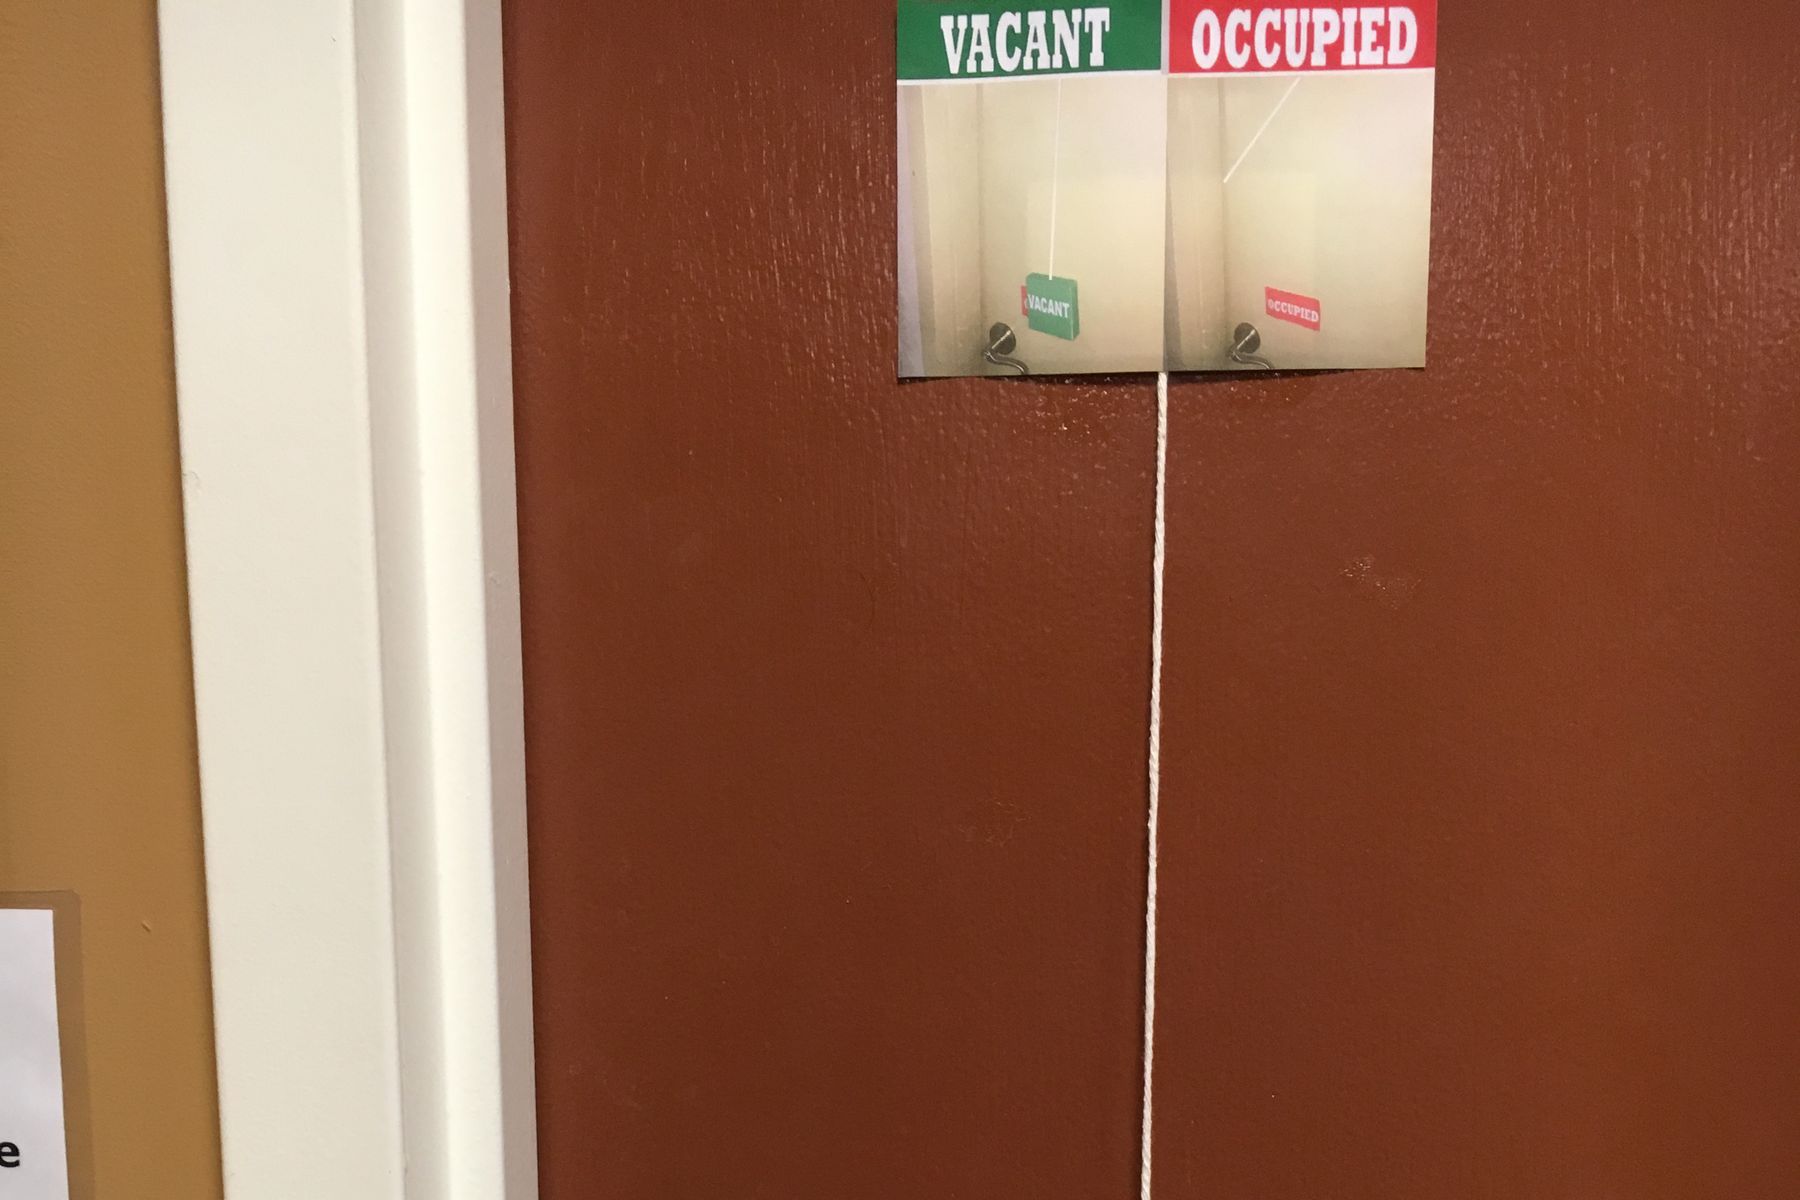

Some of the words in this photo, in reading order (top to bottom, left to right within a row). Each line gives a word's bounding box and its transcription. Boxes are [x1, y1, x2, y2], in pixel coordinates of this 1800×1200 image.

[940, 8, 1110, 74] VACANT
[1191, 6, 1418, 70] OCCUPIED
[1027, 293, 1070, 319] VACANT
[1267, 298, 1319, 323] OCCUPIED
